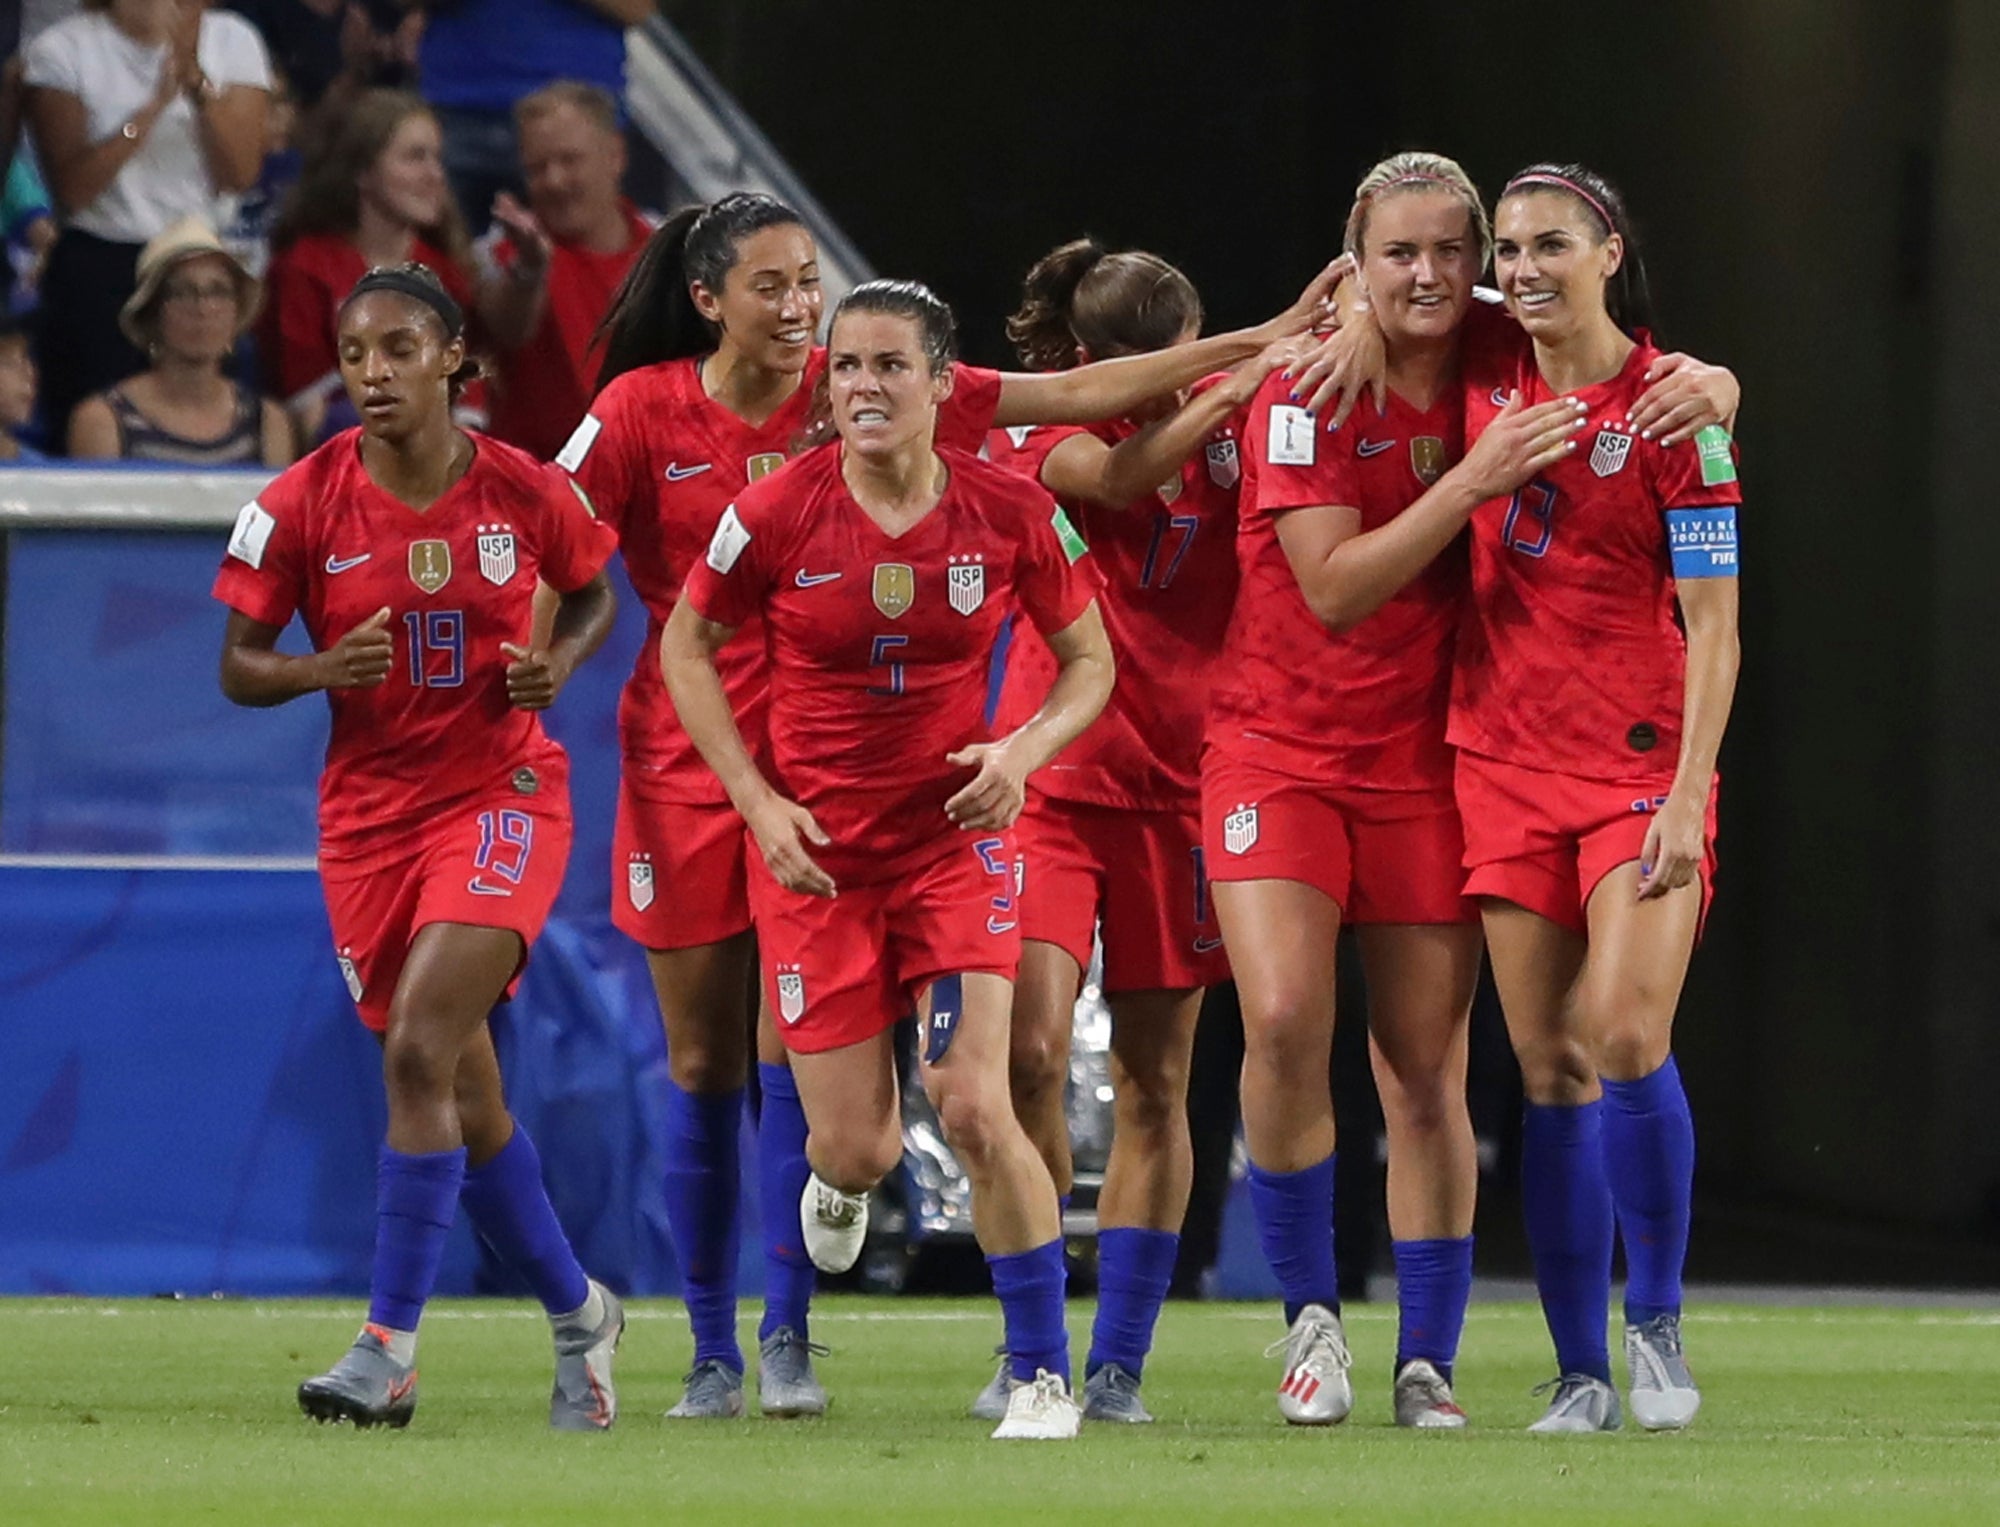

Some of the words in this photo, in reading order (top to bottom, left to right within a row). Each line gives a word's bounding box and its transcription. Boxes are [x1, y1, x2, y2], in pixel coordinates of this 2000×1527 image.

[1139, 516, 1199, 588] 17
[1502, 480, 1557, 558] 13
[402, 610, 464, 688] 19
[867, 634, 909, 696] 5
[474, 809, 533, 884] 19
[972, 838, 1011, 911] 5
[934, 1012, 952, 1029] KT
